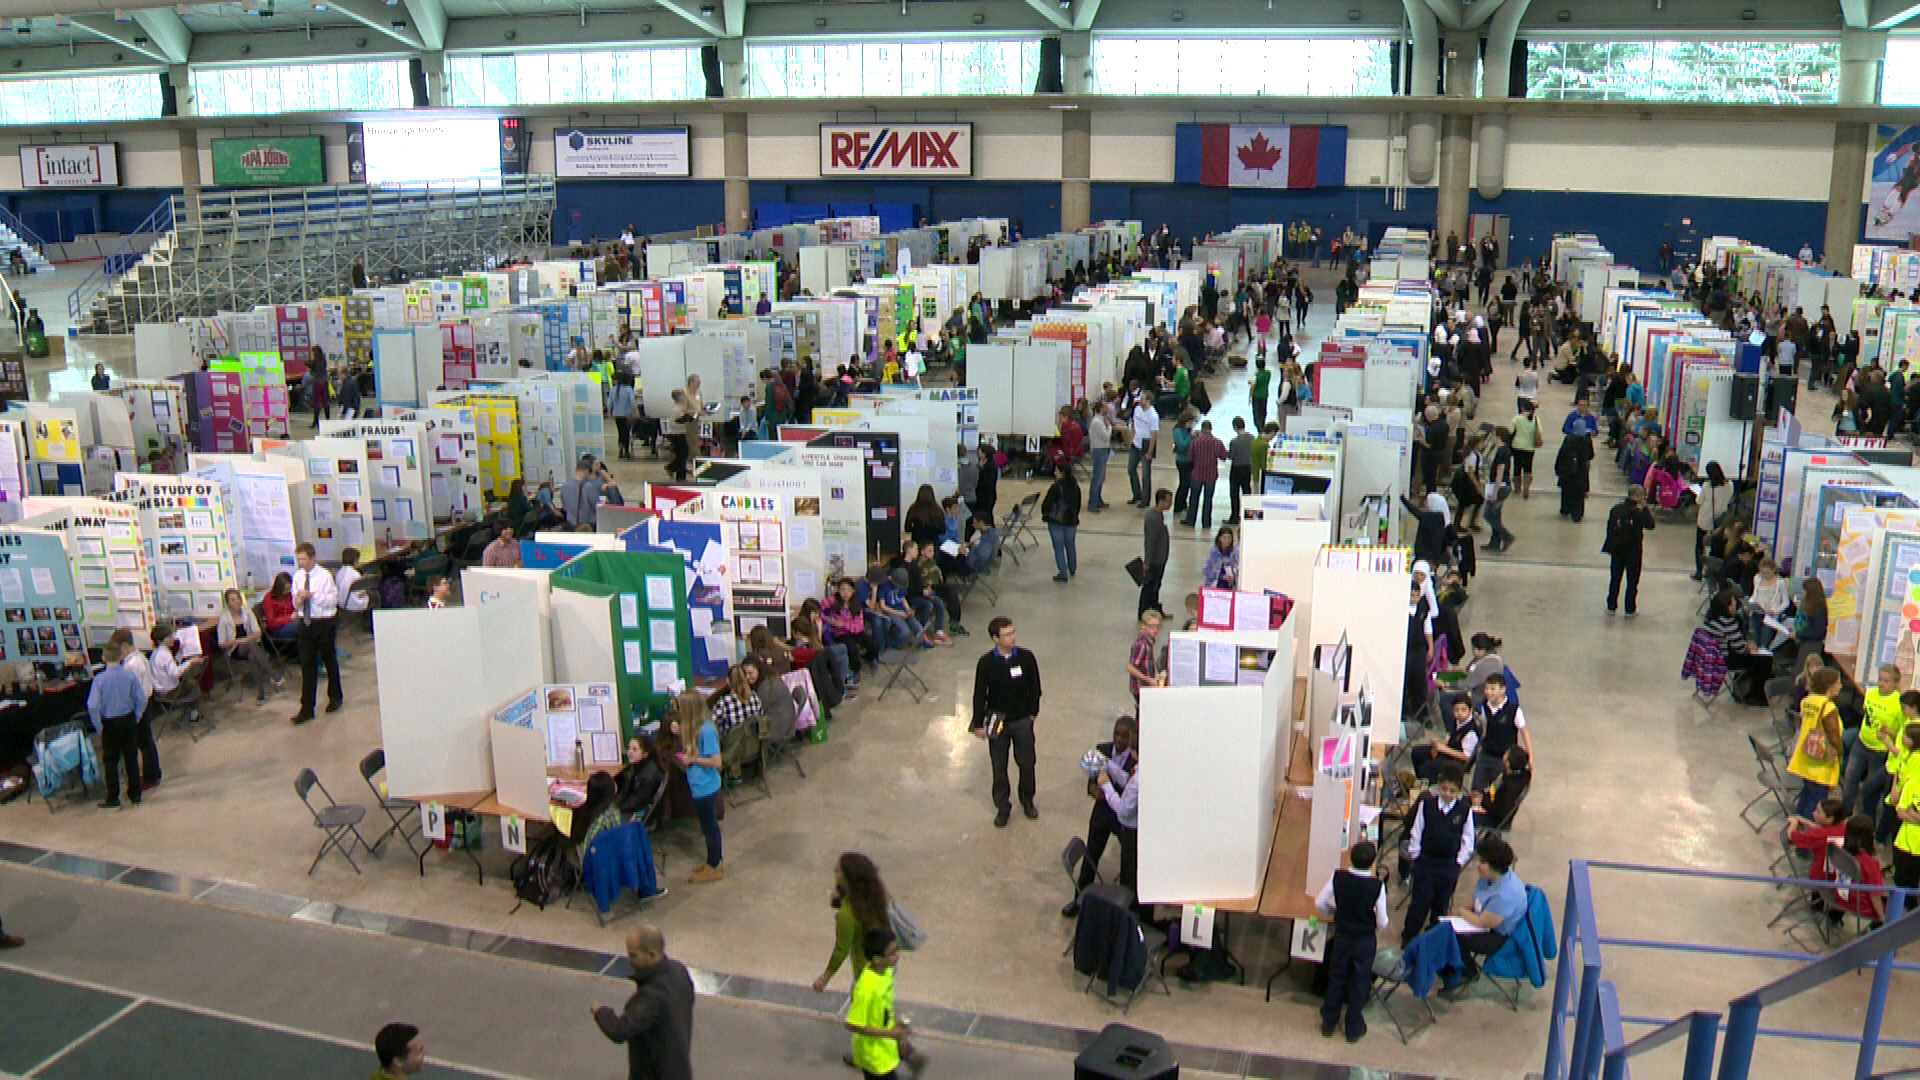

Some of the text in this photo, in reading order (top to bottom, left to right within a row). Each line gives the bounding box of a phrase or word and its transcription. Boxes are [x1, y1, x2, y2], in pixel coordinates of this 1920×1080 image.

[586, 136, 633, 146] SKYLINE
[831, 128, 960, 170] RE/MAX
[45, 154, 93, 176] intact
[1029, 436, 1039, 450] N
[152, 485, 193, 496] STUDY
[195, 485, 212, 496] OF
[721, 495, 774, 511] CANDLES
[74, 517, 107, 528] AWAY
[428, 811, 438, 832] P
[508, 824, 520, 846] N
[1192, 915, 1203, 940] L
[1301, 927, 1319, 953] K
